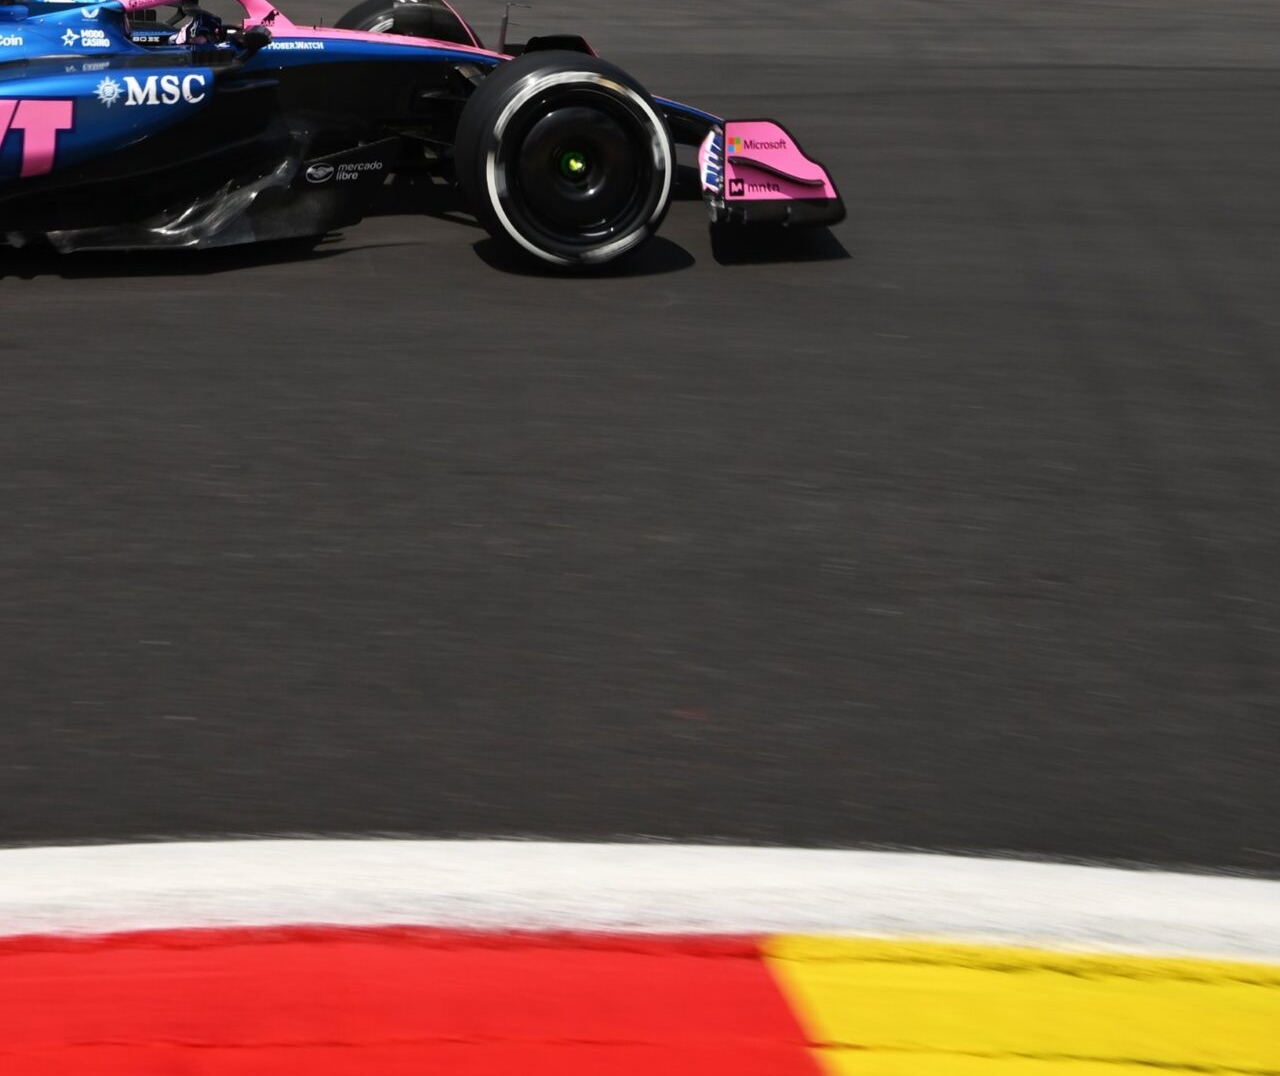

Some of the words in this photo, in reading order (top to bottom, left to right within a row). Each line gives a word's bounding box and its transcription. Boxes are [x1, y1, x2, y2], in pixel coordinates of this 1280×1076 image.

[123, 75, 205, 106] MSC
[743, 139, 787, 150] Microsoft
[338, 161, 383, 172] mercado
[336, 172, 358, 180] libre
